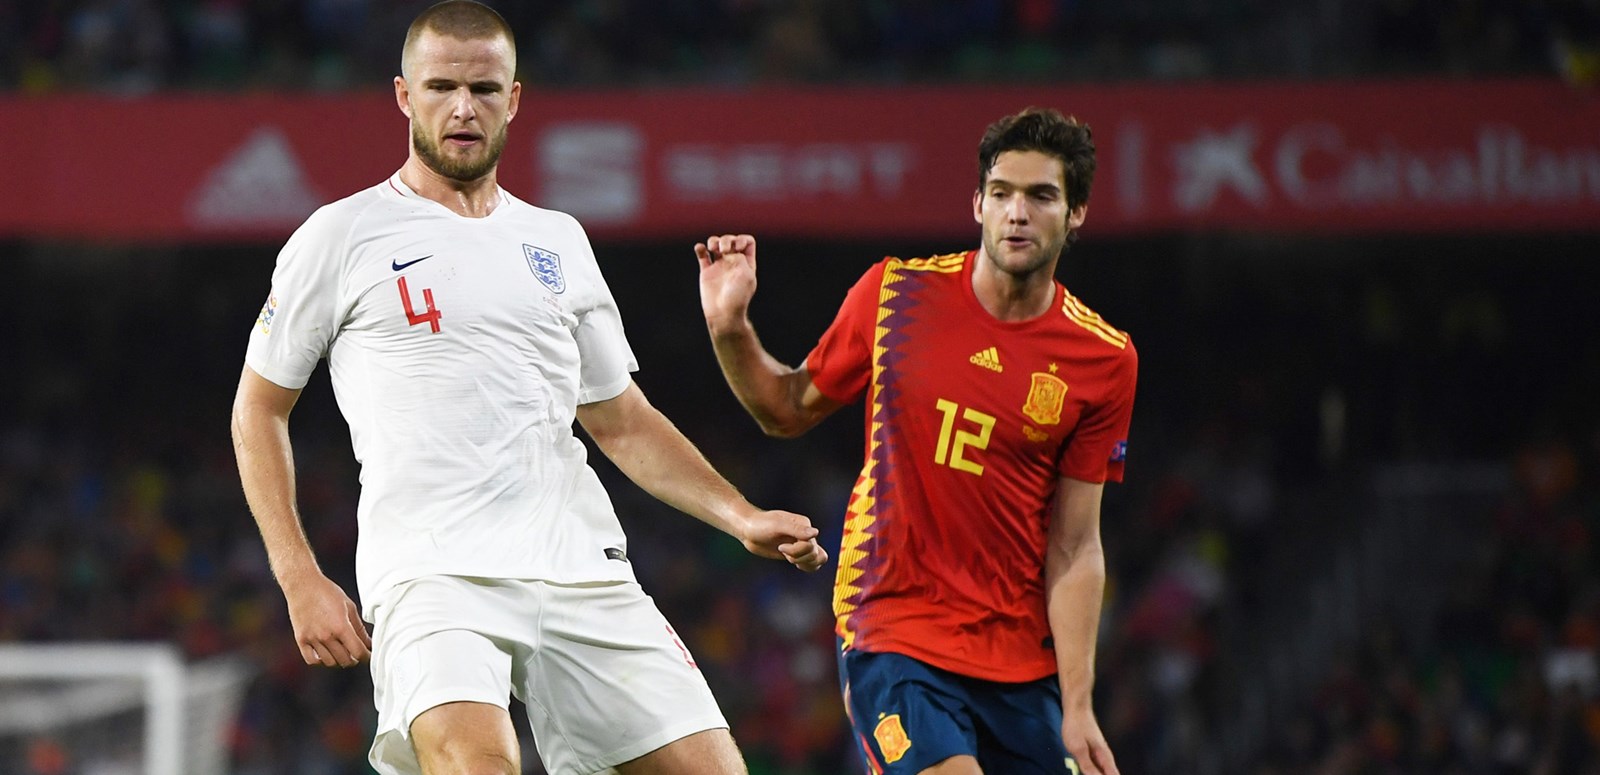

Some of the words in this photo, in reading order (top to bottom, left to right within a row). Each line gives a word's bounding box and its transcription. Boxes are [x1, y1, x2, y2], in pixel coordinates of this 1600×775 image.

[662, 143, 913, 199] SEAT
[397, 276, 442, 334] 4
[970, 355, 1003, 373] adidas
[934, 398, 997, 476] 12
